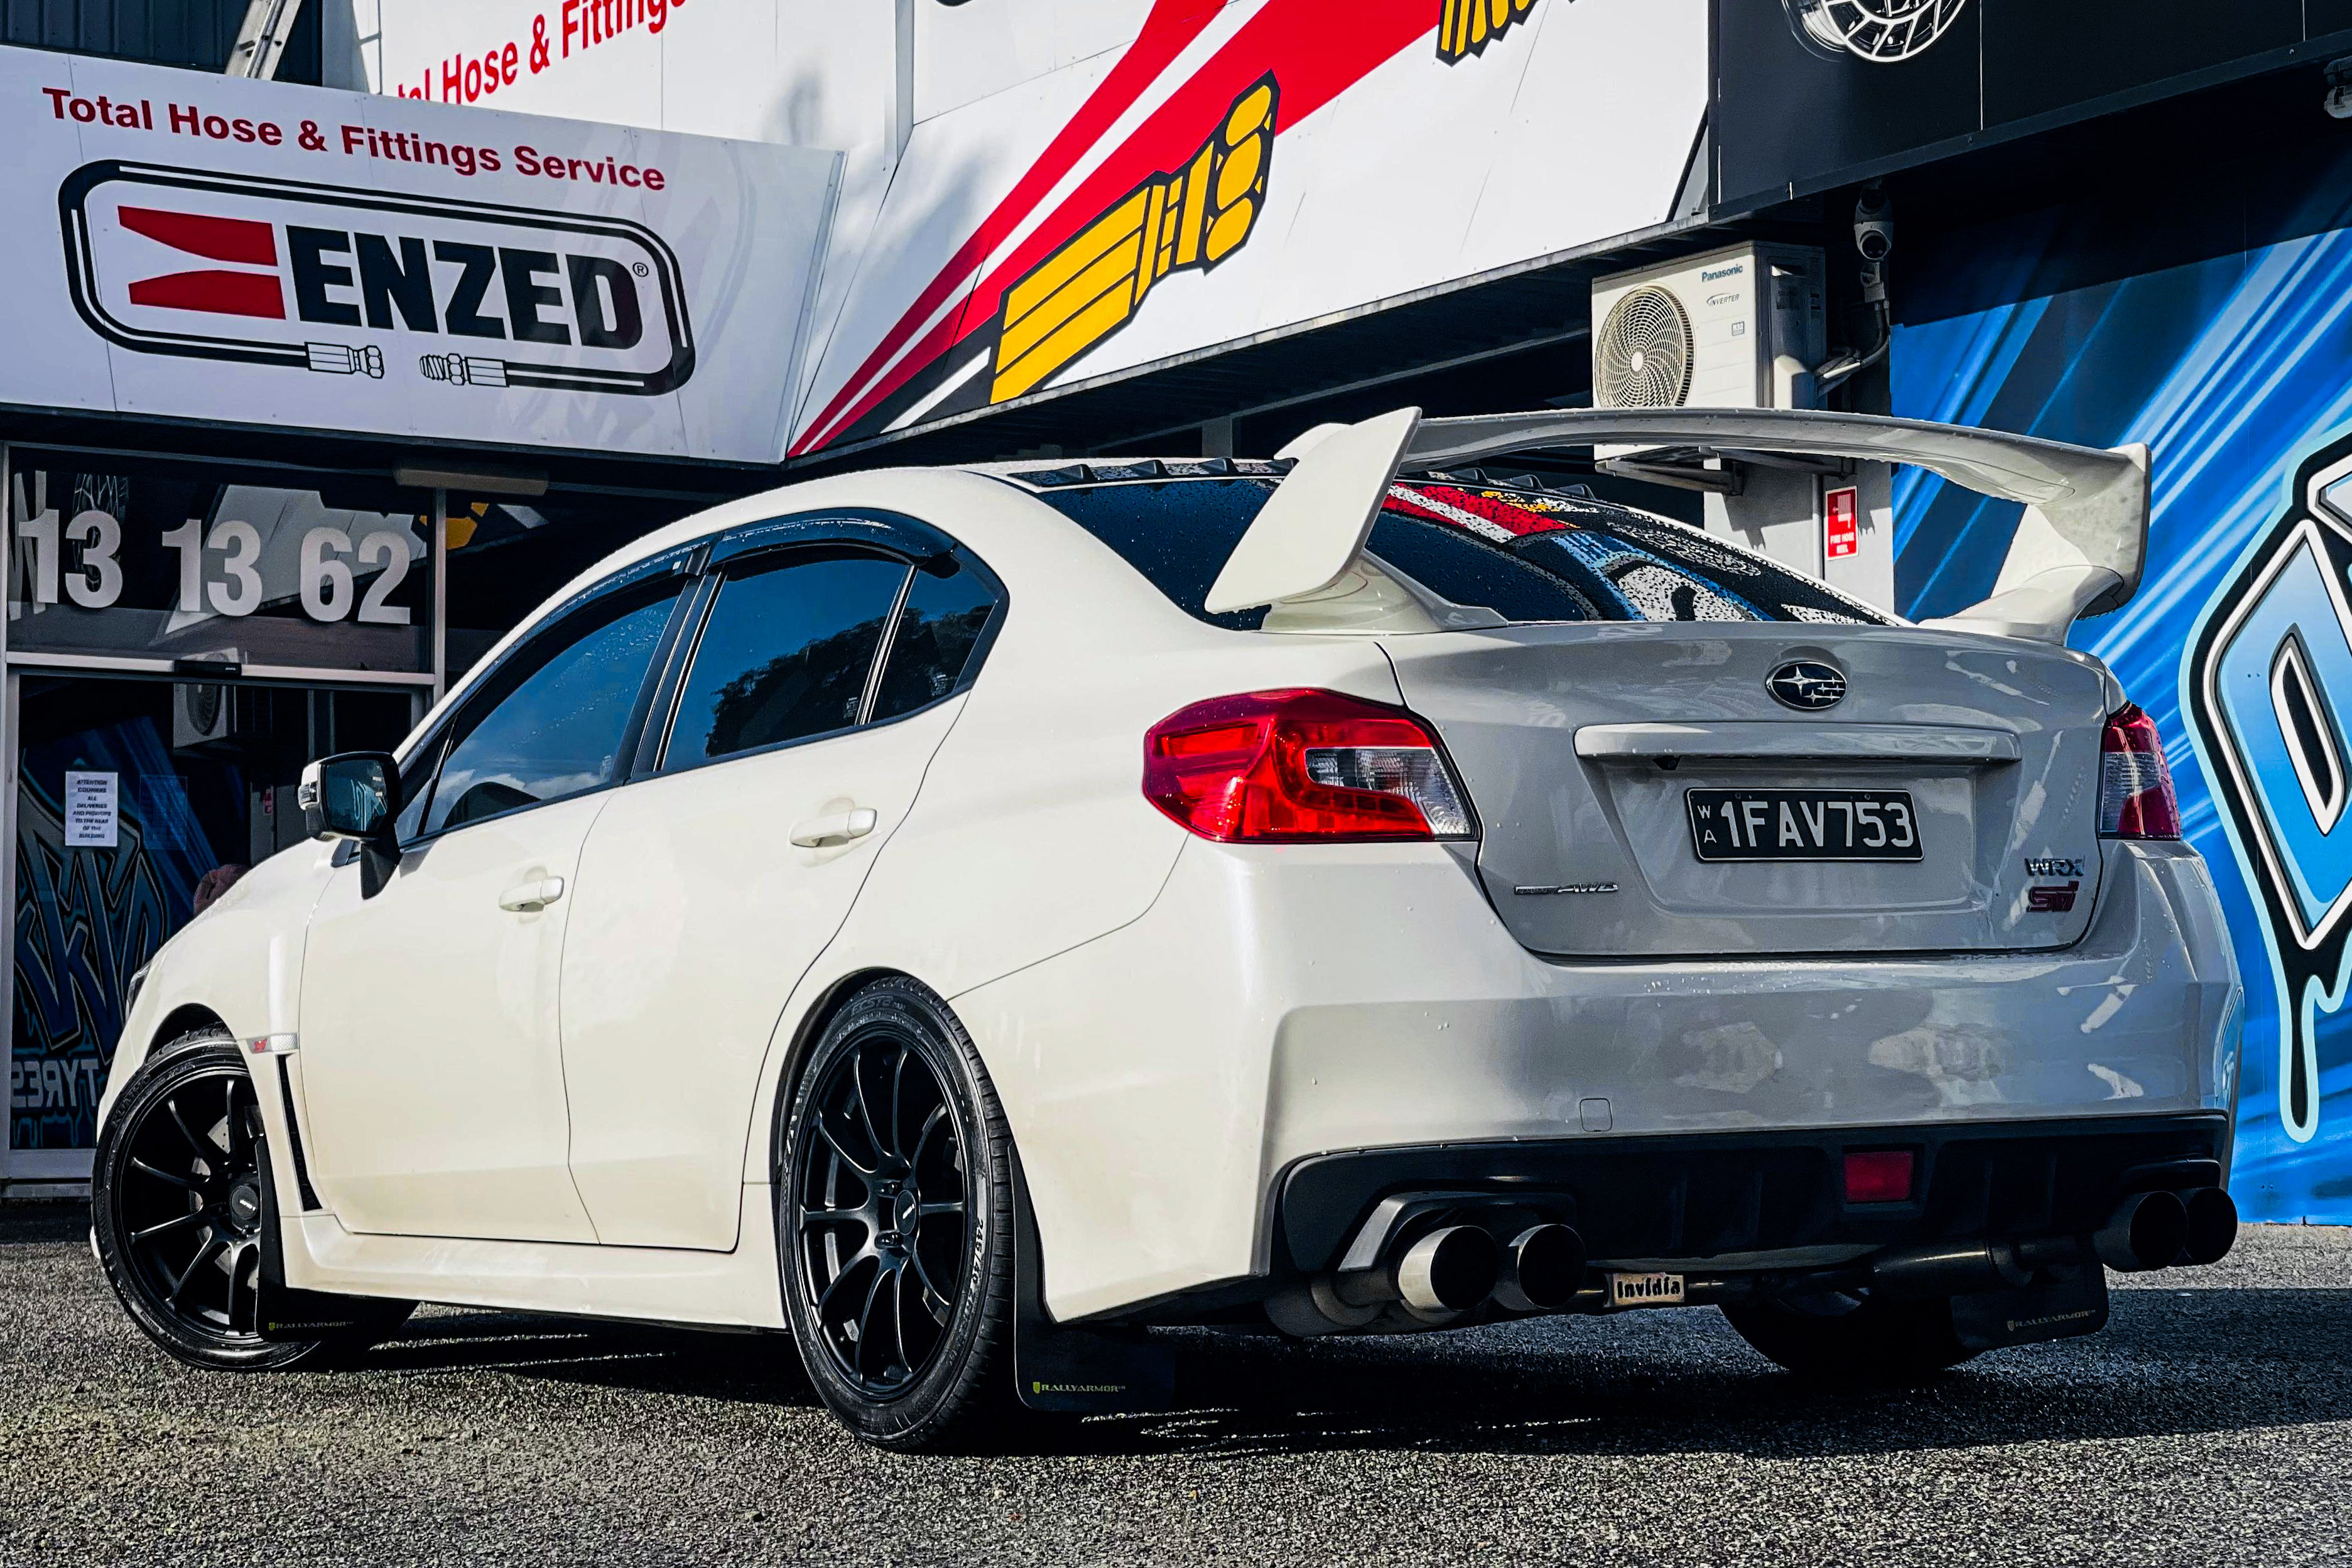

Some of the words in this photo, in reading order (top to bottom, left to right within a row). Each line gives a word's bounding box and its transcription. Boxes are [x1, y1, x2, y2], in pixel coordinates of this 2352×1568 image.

[443, 42, 518, 104] Hose
[529, 14, 550, 74] &
[562, 0, 687, 58] Fitting
[42, 87, 153, 130] Total
[168, 103, 283, 146] Hose
[298, 120, 328, 152] &
[340, 125, 501, 176] Fittings
[514, 146, 664, 191] Service
[1702, 263, 1743, 282] Panasonic
[1830, 534, 1841, 544] FIRE
[1841, 531, 1855, 543] HOSE
[1836, 544, 1848, 554] REEL
[18, 509, 123, 608] 13
[162, 519, 262, 617] 13
[300, 527, 410, 624] 62
[2024, 858, 2084, 877] WRX
[1558, 881, 1618, 893] AWD
